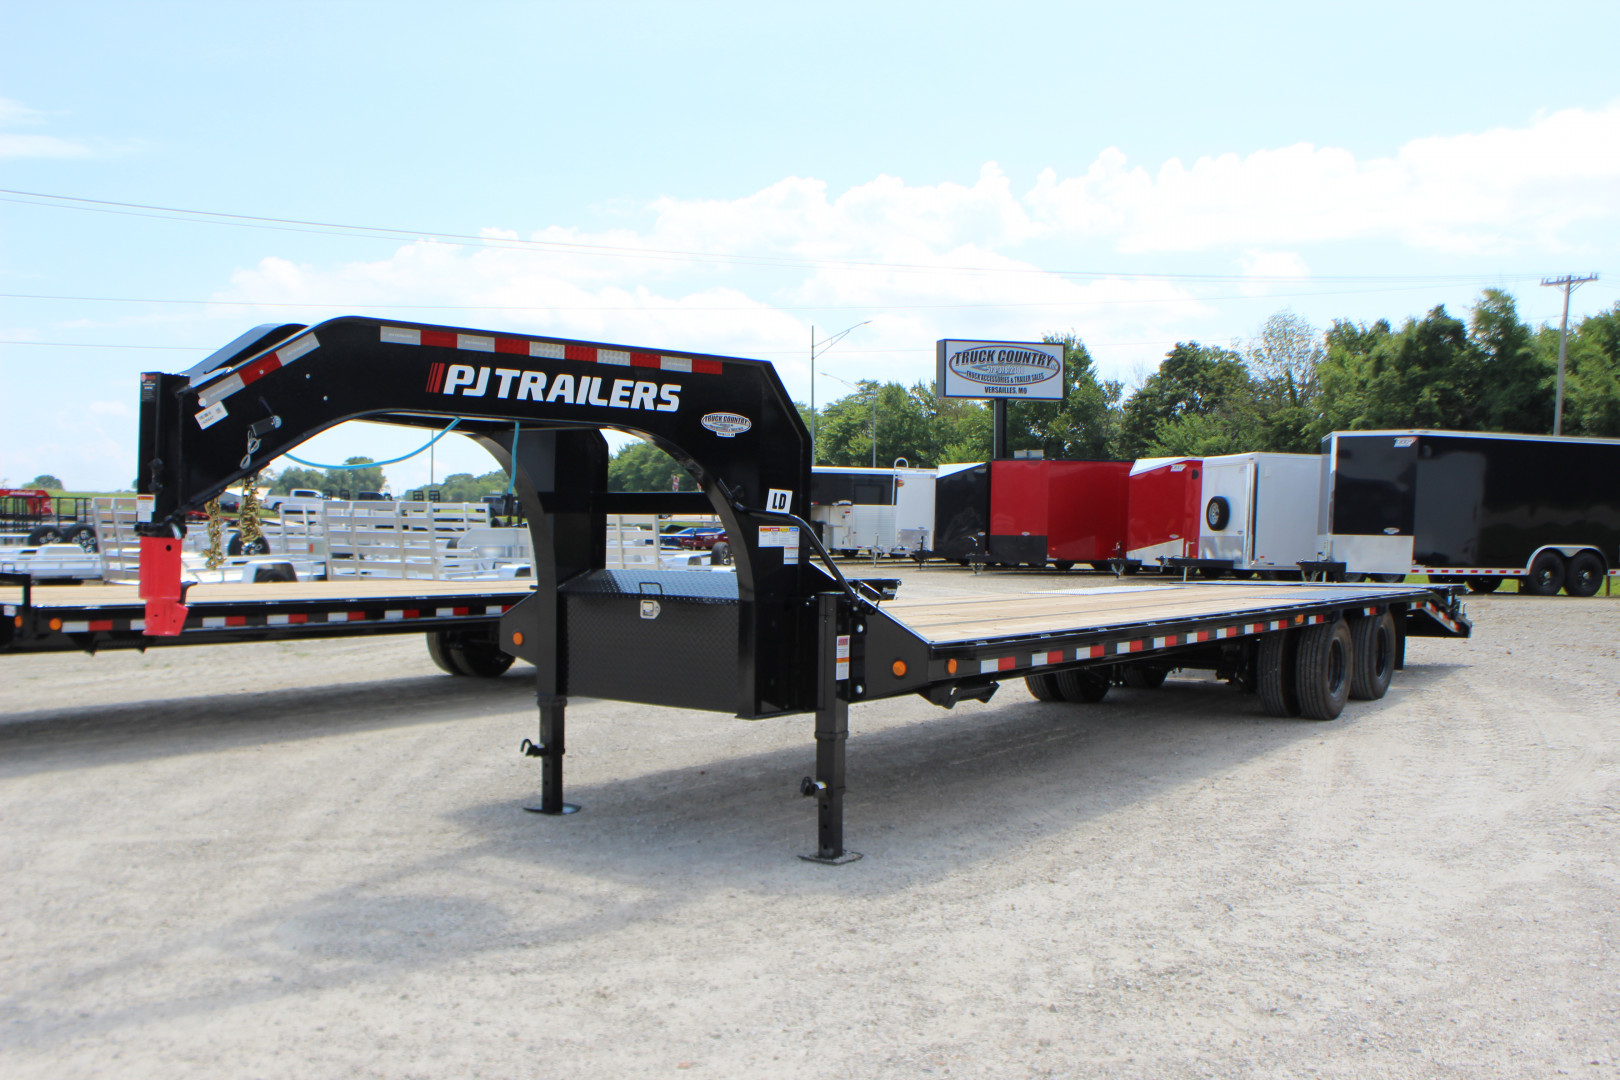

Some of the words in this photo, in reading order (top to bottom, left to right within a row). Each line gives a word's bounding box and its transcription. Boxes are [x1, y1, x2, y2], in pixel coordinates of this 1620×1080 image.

[955, 350, 995, 365] TRUCK
[997, 350, 1054, 366] COUNTRY
[966, 371, 980, 380] TRUCK
[1014, 374, 1031, 384] TRAILER
[1031, 372, 1045, 382] SALES
[443, 364, 490, 397] PJ
[495, 367, 682, 412] TRAILERS
[772, 492, 787, 510] LD
